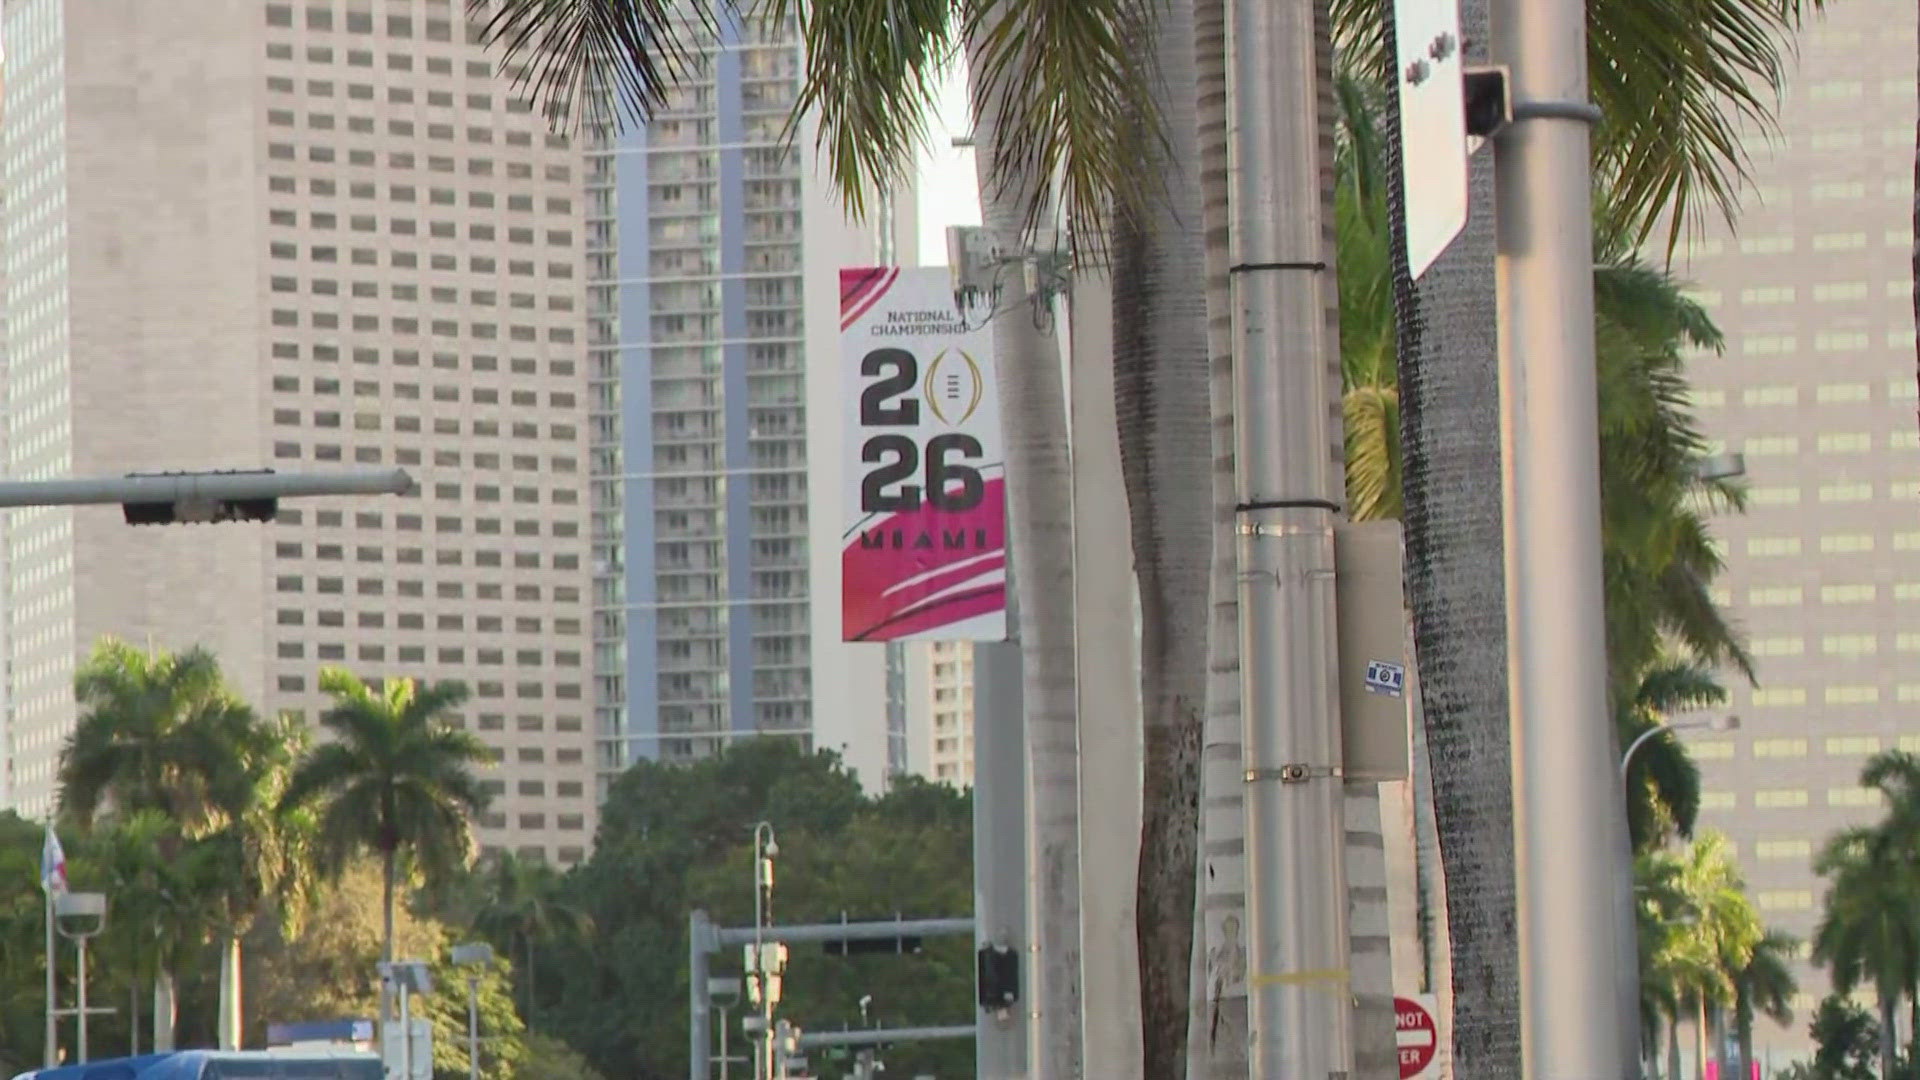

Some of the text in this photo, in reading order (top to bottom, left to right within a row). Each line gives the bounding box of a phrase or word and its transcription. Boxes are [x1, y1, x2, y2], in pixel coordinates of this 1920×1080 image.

[887, 310, 954, 323] NATIONAL
[870, 323, 971, 337] CHAMPIONSHIP
[861, 433, 985, 514] 26
[861, 529, 987, 551] MIAMI
[1394, 1011, 1424, 1028] NOT
